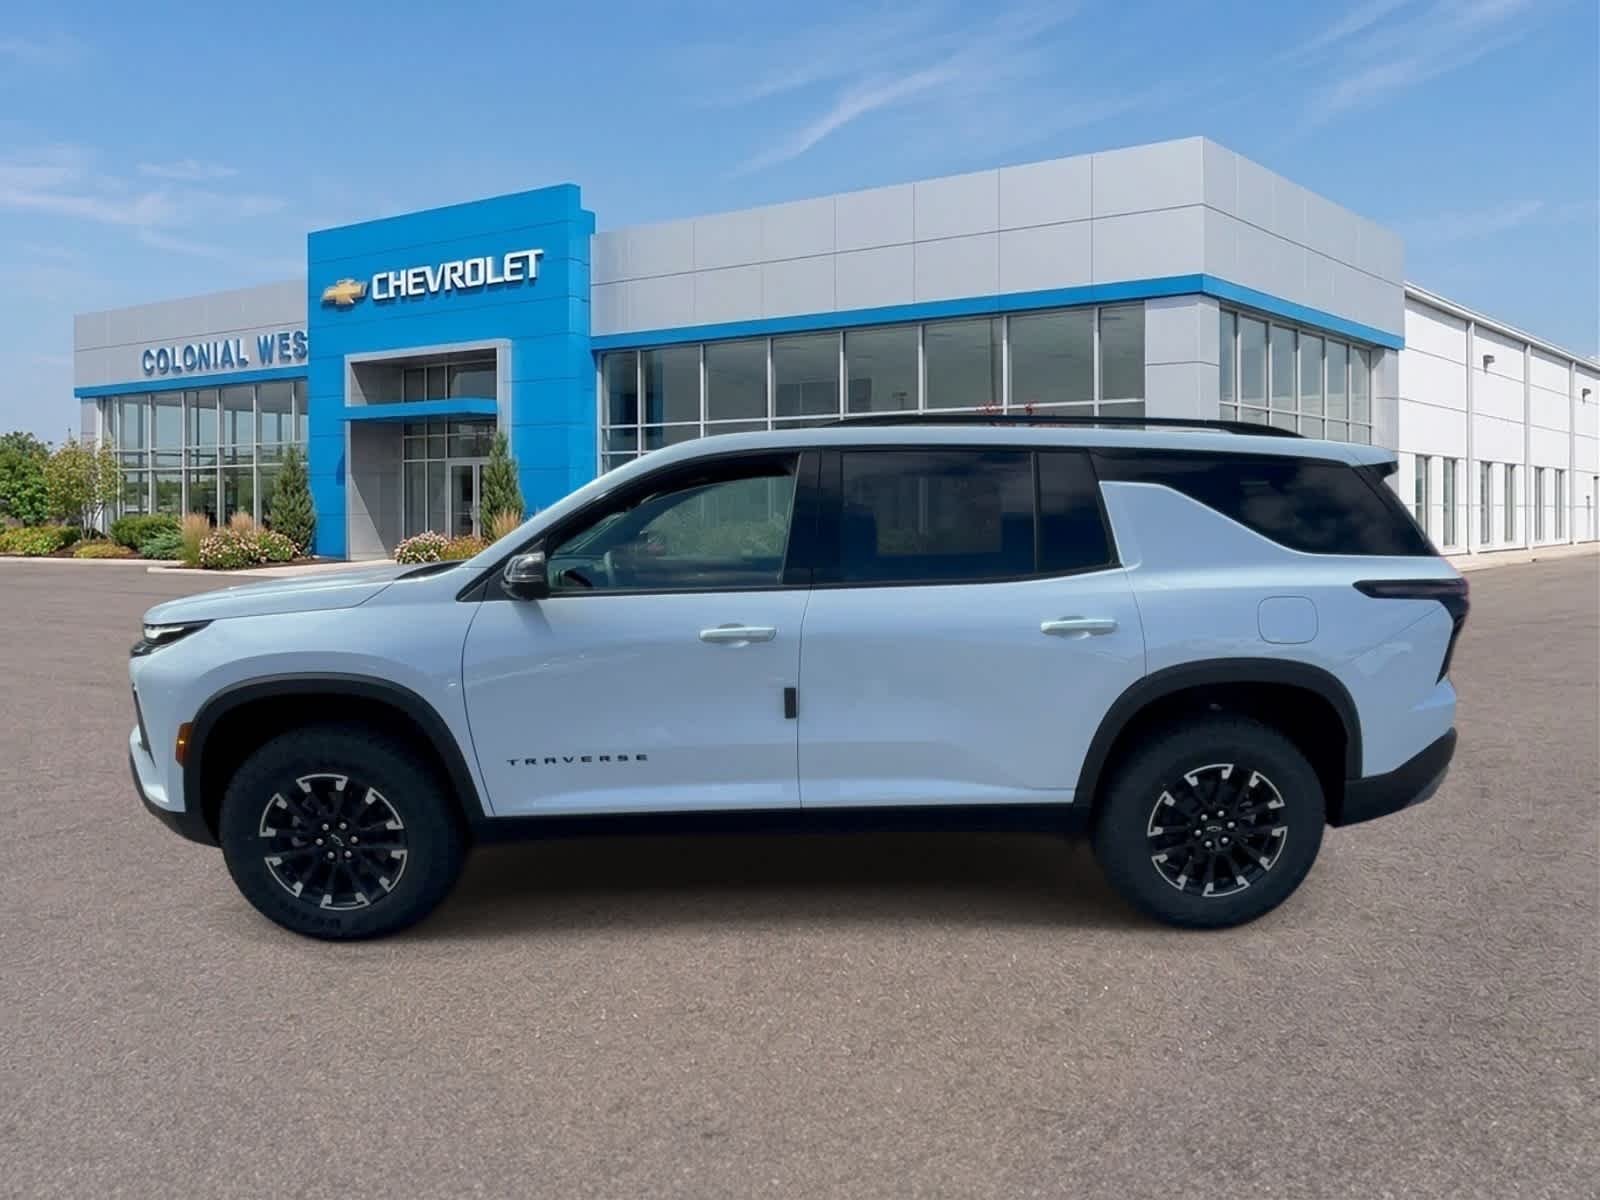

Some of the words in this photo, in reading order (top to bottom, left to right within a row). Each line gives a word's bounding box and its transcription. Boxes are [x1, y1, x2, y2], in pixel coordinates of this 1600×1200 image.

[371, 248, 544, 301] CHEVROLET
[142, 338, 249, 377] COLONIAL
[506, 754, 648, 766] TRAVERSE
